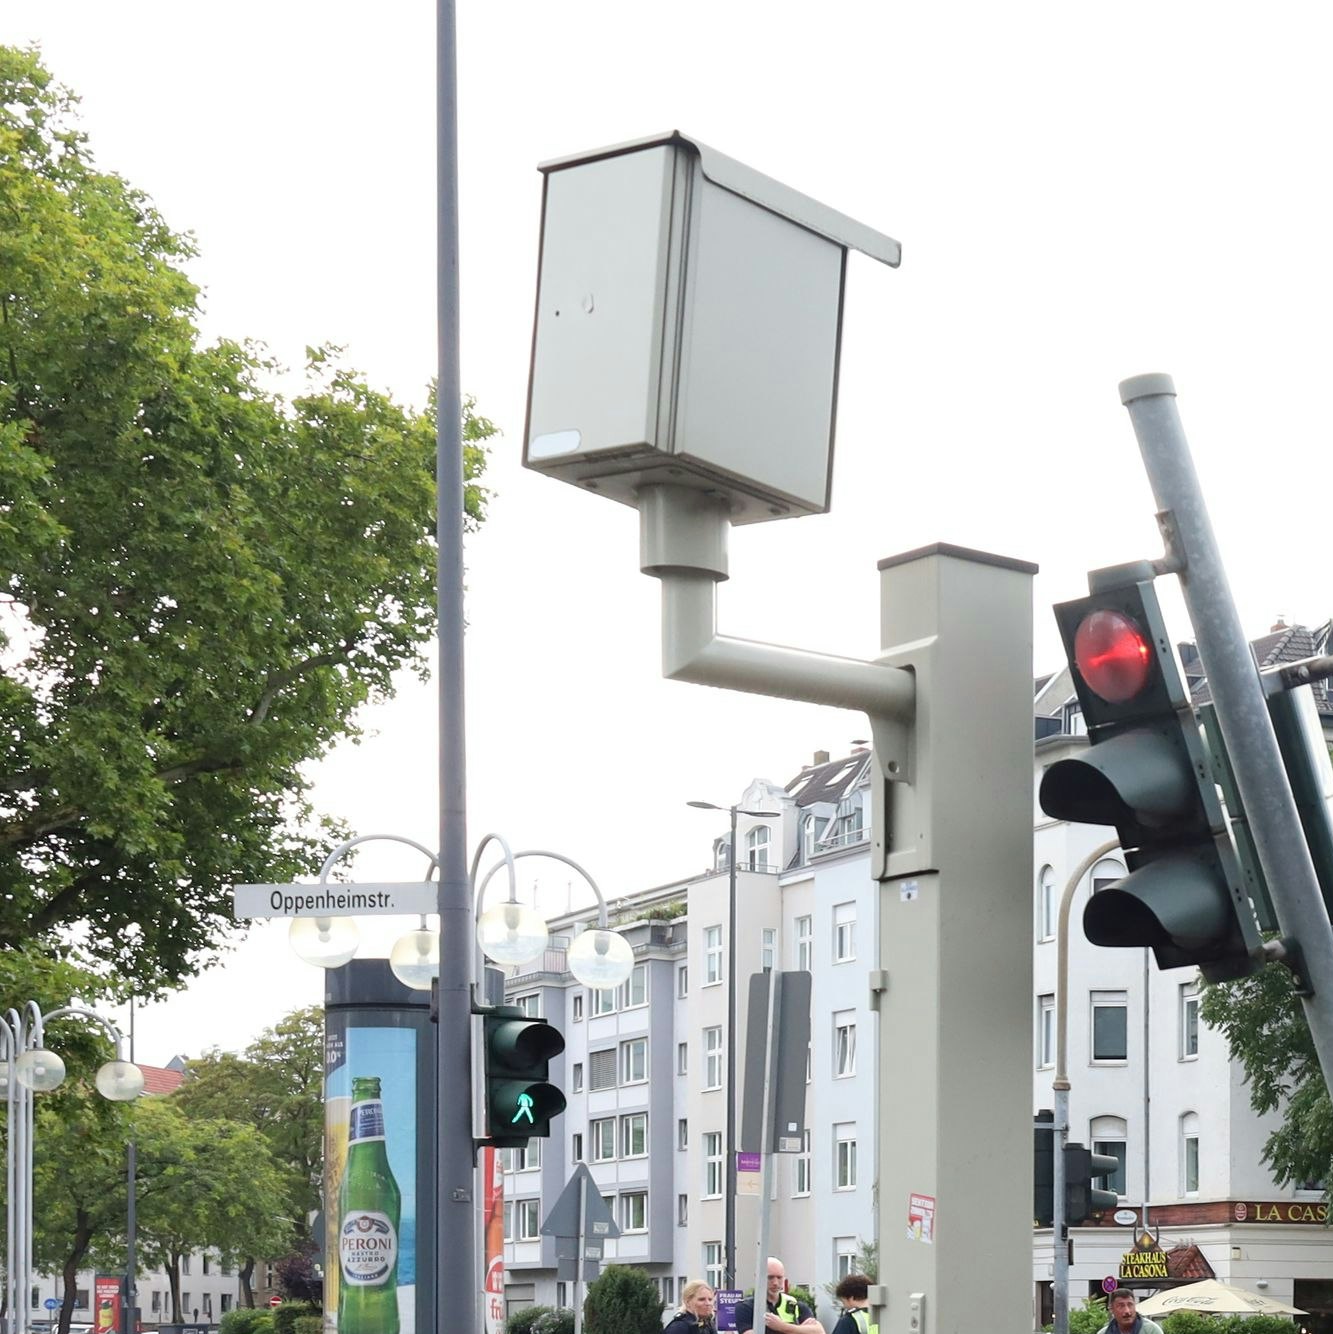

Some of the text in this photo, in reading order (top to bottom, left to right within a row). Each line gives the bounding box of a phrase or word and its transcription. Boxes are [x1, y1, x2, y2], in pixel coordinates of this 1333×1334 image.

[270, 889, 396, 914] Oppenheimstr.
[1254, 1204, 1329, 1222] LA CAS
[342, 1237, 392, 1251] PERONI
[1121, 1251, 1167, 1265] STEAKHAUS
[1120, 1264, 1168, 1278] LA CASONA
